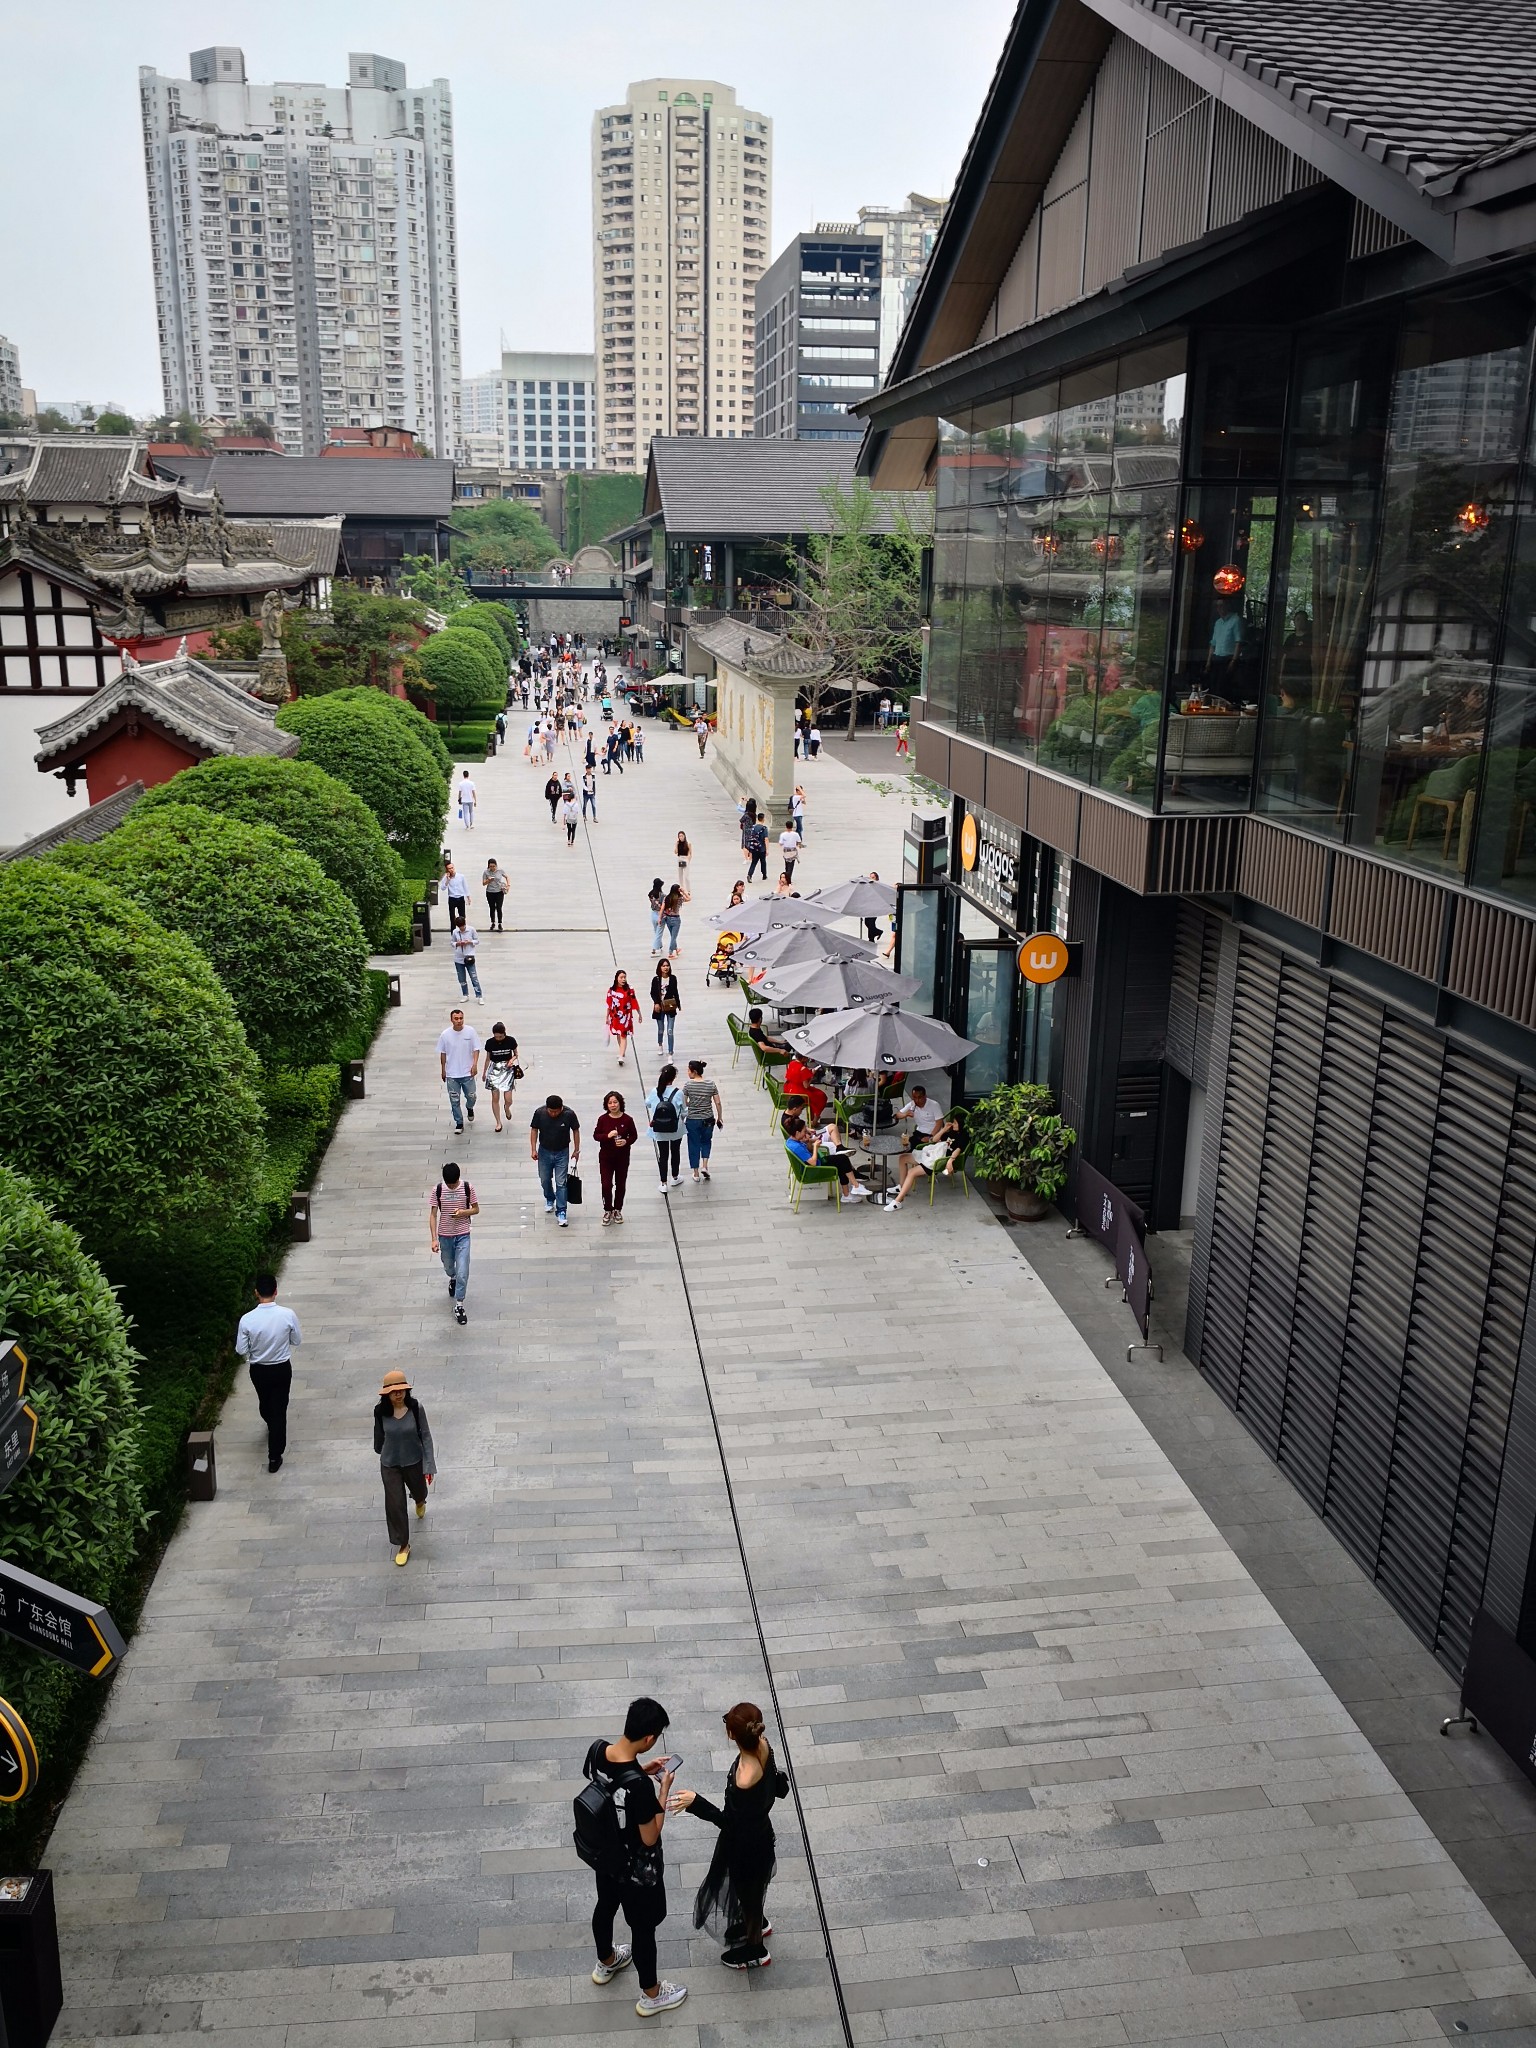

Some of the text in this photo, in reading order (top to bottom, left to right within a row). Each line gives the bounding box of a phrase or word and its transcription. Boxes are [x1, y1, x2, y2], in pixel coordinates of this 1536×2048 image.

[979, 838, 1015, 882] wagas
[1030, 951, 1058, 970] w
[865, 991, 893, 1001] wagas
[899, 1053, 932, 1063] wagas
[4, 1429, 20, 1459] 东里
[18, 1598, 71, 1637] 广东会馆
[28, 1621, 60, 1643] GUANGDONG
[60, 1637, 74, 1650] HALL
